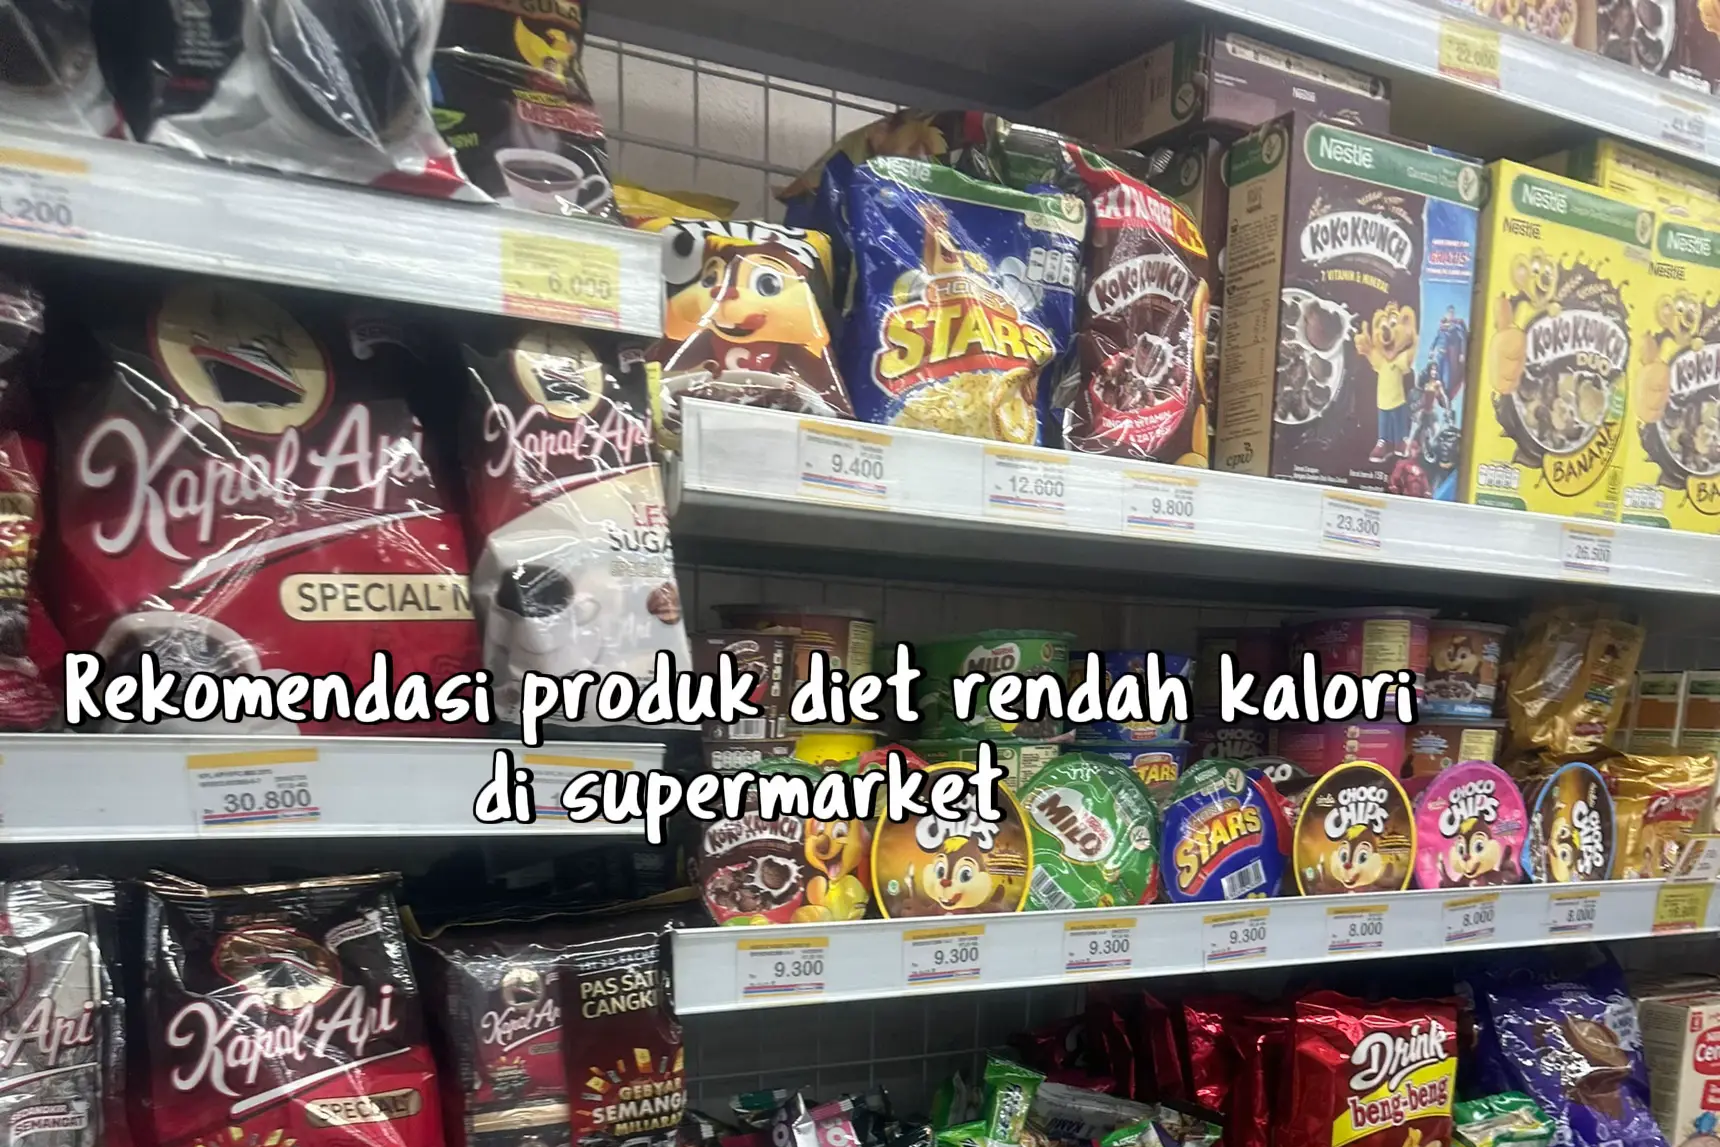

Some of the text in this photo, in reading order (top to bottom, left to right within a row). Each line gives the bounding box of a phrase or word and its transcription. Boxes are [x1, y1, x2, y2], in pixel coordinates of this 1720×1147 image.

[1309, 217, 1349, 254] KOKO
[1350, 216, 1409, 265] KRUNCH
[879, 298, 1057, 381] STARS
[1532, 317, 1572, 361] KOKO
[485, 401, 655, 478] Kapal Api
[1552, 420, 1617, 483] BANANA
[80, 403, 428, 561] Kapal Api
[831, 453, 885, 481] 9.400
[1010, 475, 1065, 499] 12.600
[1152, 497, 1195, 518] 9.800
[1337, 514, 1381, 537] 23.300
[223, 788, 313, 814] 30.800
[1338, 785, 1389, 803] CHOCO
[1448, 779, 1496, 805] CHOCO
[1034, 792, 1102, 858] MILO
[1324, 802, 1390, 839] CHIPS
[1439, 796, 1500, 838] CHIPS
[708, 822, 745, 851] KOKO
[1177, 806, 1263, 890] STARS
[1348, 922, 1383, 938] 8.000
[1462, 909, 1496, 928] 8.000
[1088, 938, 1131, 957] 9.300
[1229, 926, 1268, 946] 9.300
[774, 960, 825, 980] 9.300
[933, 946, 980, 967] 9.300
[580, 969, 660, 1001] PAS SAT
[3, 997, 95, 1068] Api
[167, 983, 400, 1097] Kapal Api
[1349, 1017, 1449, 1092] Drink
[619, 1078, 683, 1100] GEBYAR
[1348, 1074, 1450, 1131] beng-beng
[319, 1095, 411, 1119] SPECIAL
[592, 1091, 687, 1123] SEMANG
